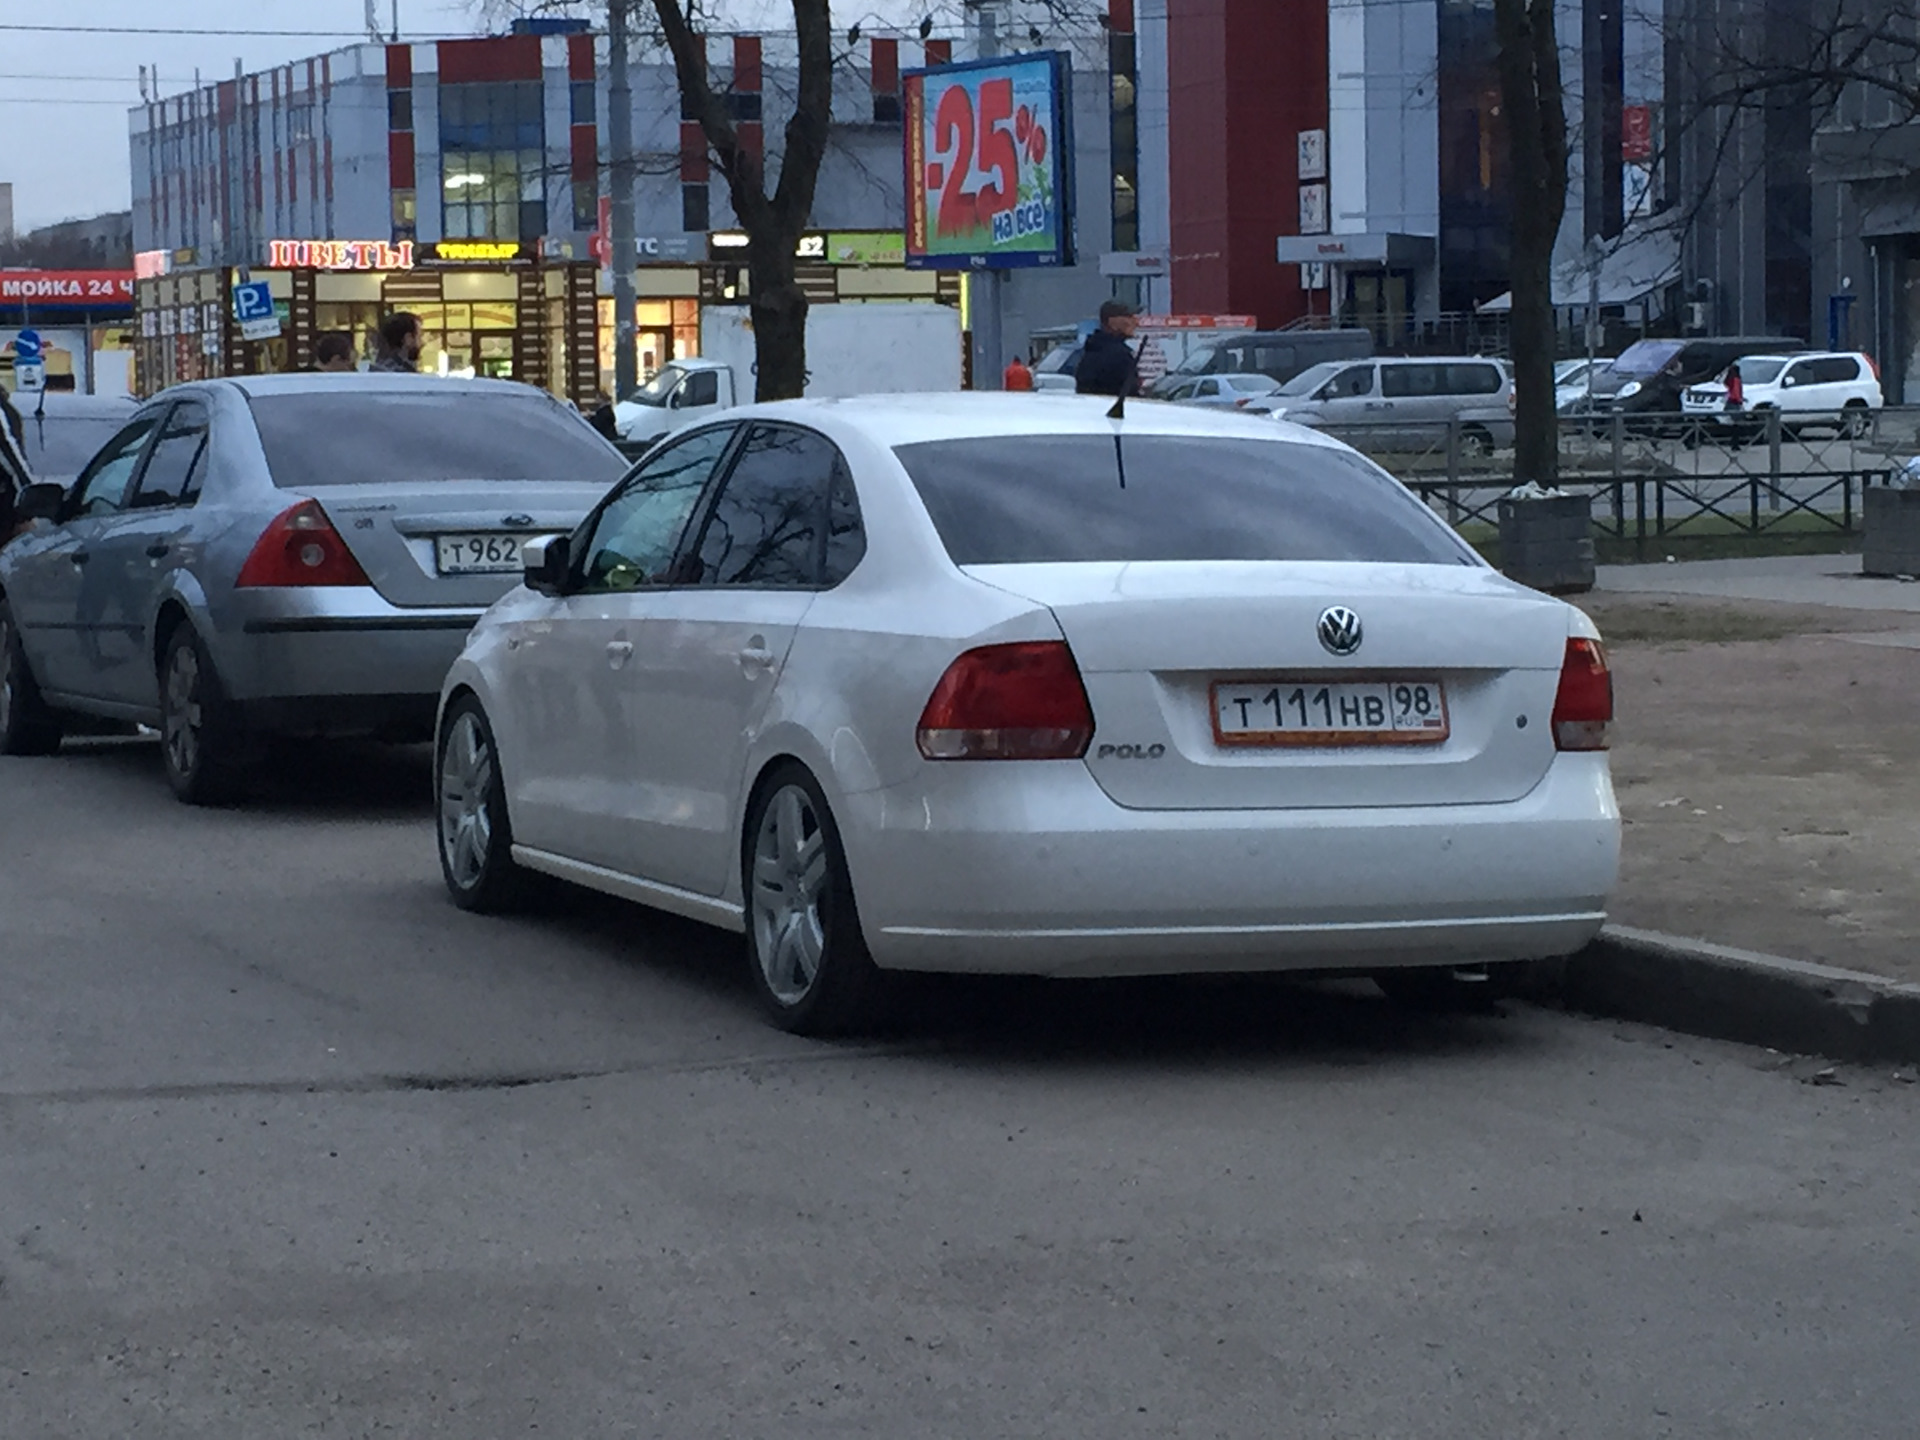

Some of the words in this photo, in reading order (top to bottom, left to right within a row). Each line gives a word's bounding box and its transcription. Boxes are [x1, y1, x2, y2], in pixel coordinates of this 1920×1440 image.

[927, 78, 1047, 238] -25%
[270, 240, 415, 269] ЦВЕТЫ
[634, 237, 659, 254] ТС
[2, 278, 83, 297] МОЙКА
[88, 279, 114, 296] 24
[450, 537, 518, 564] Т962
[1395, 685, 1432, 715] 98
[1097, 743, 1166, 760] POLO
